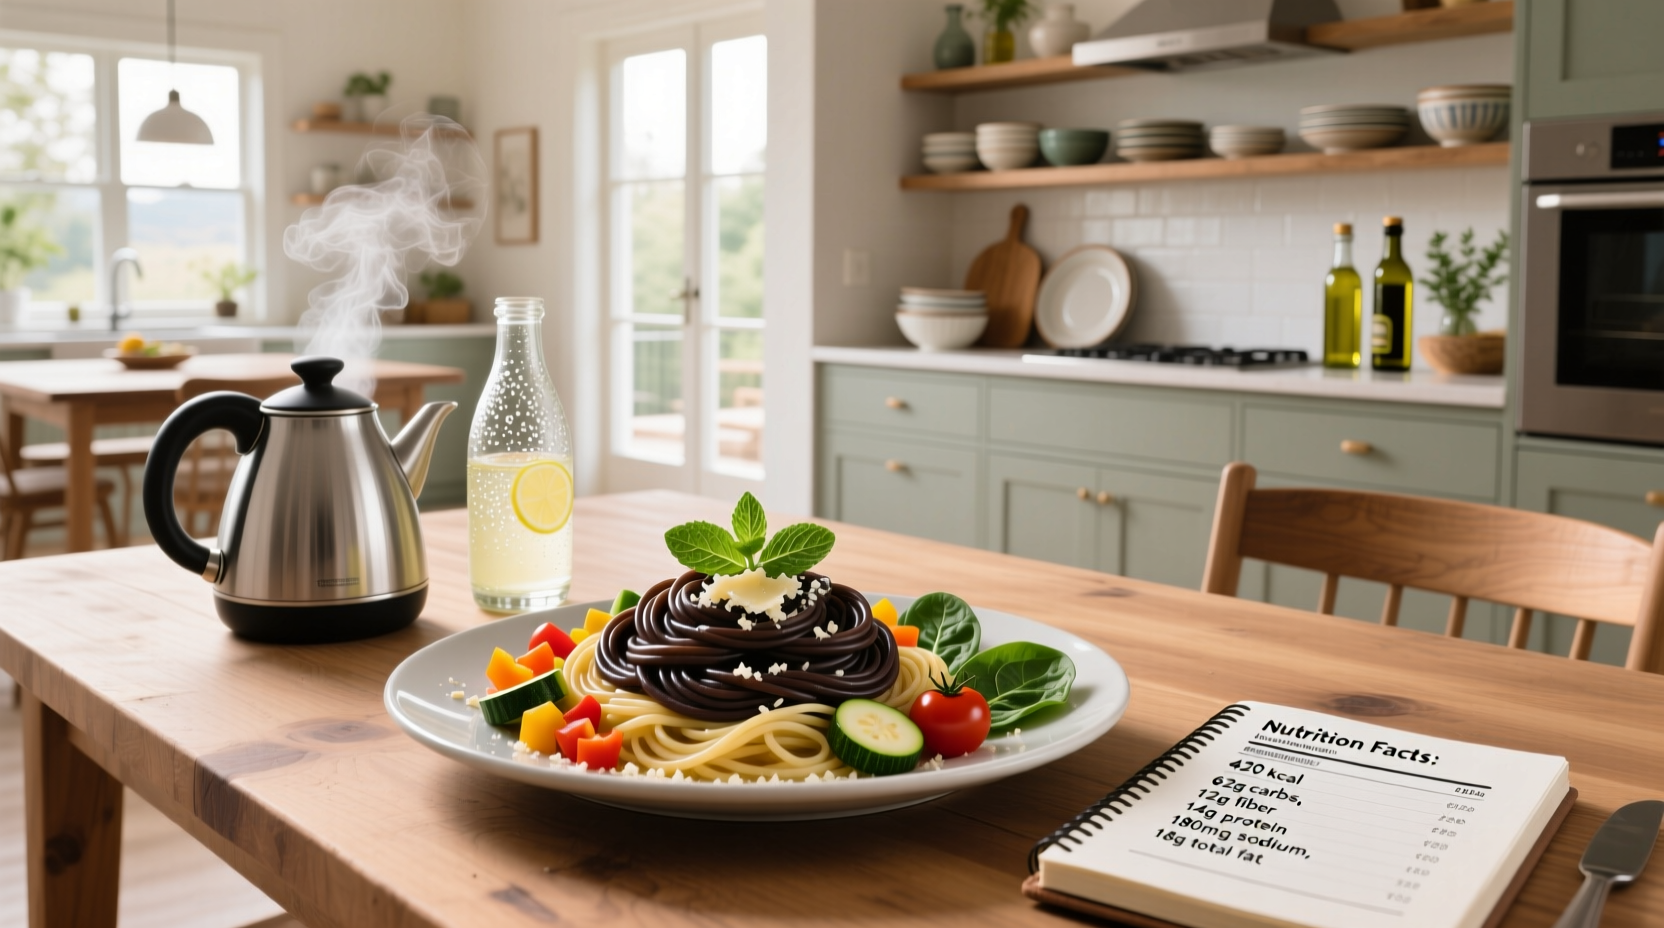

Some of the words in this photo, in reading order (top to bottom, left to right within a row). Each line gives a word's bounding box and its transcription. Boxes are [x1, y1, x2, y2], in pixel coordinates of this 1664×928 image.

[1262, 719, 1365, 751] Nutrition
[1370, 741, 1440, 766] Facts:
[1229, 759, 1265, 775] 420
[1266, 767, 1305, 785] kcal
[1198, 788, 1231, 806] 12g
[1235, 796, 1278, 815] fiber
[1212, 775, 1247, 793] 62g
[1249, 787, 1302, 806] carbs,
[1220, 813, 1288, 835] protein
[1190, 838, 1234, 857] total
[1236, 849, 1264, 865] fat
[1237, 832, 1311, 860] sodium,
